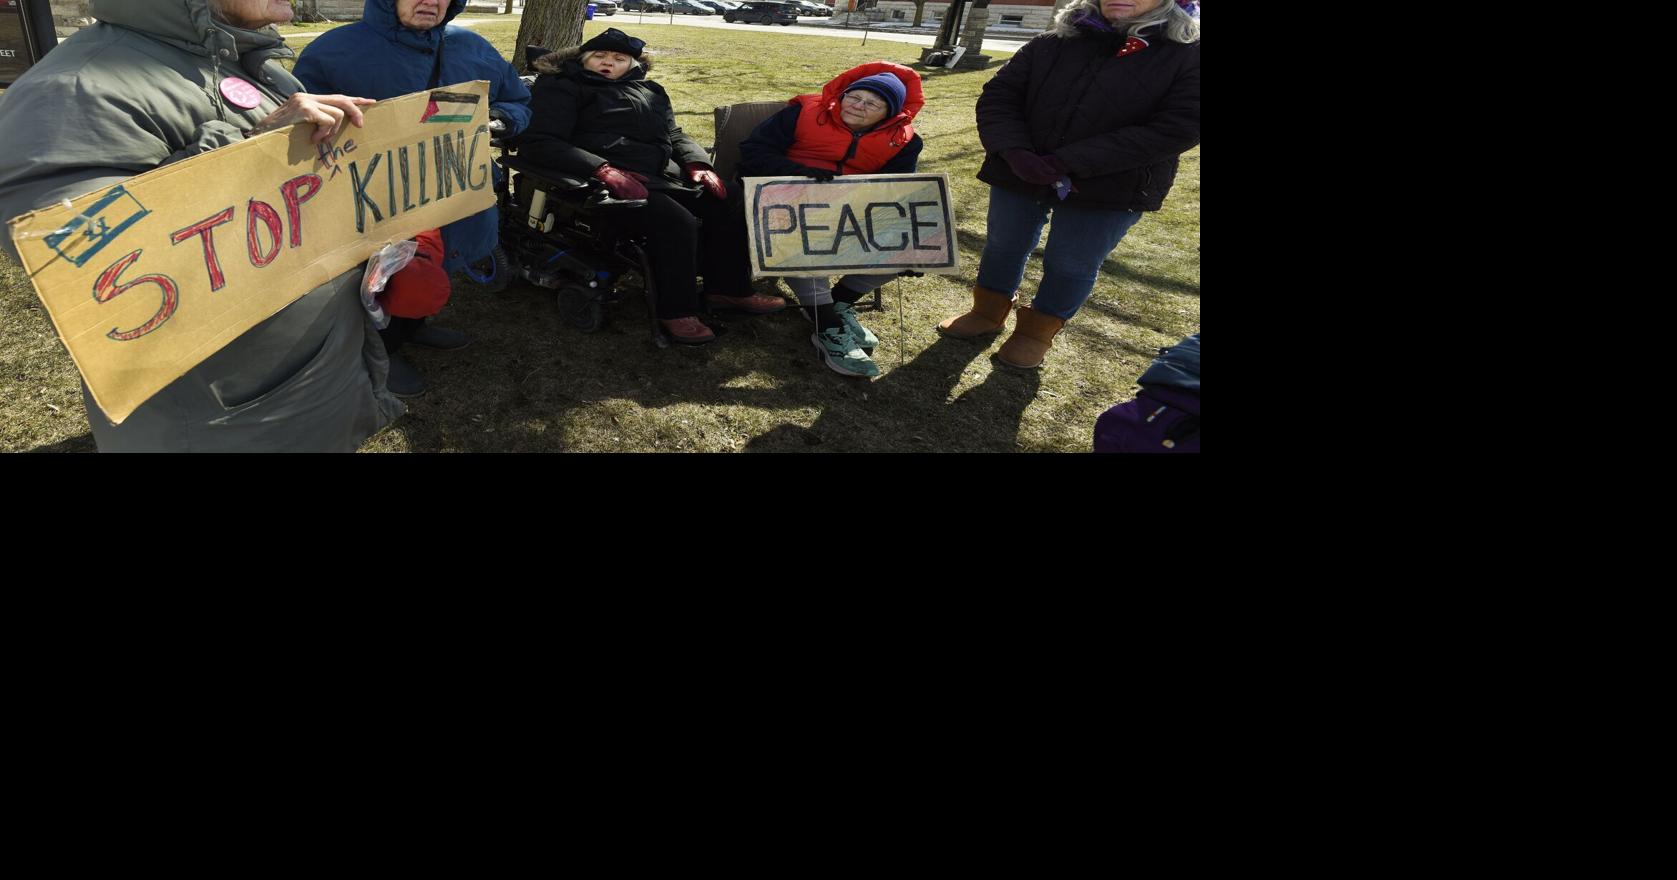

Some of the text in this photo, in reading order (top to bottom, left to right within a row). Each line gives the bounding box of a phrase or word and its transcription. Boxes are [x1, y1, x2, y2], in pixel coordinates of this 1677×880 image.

[93, 124, 488, 341] STOP the KILLING
[763, 201, 942, 258] PEACE
